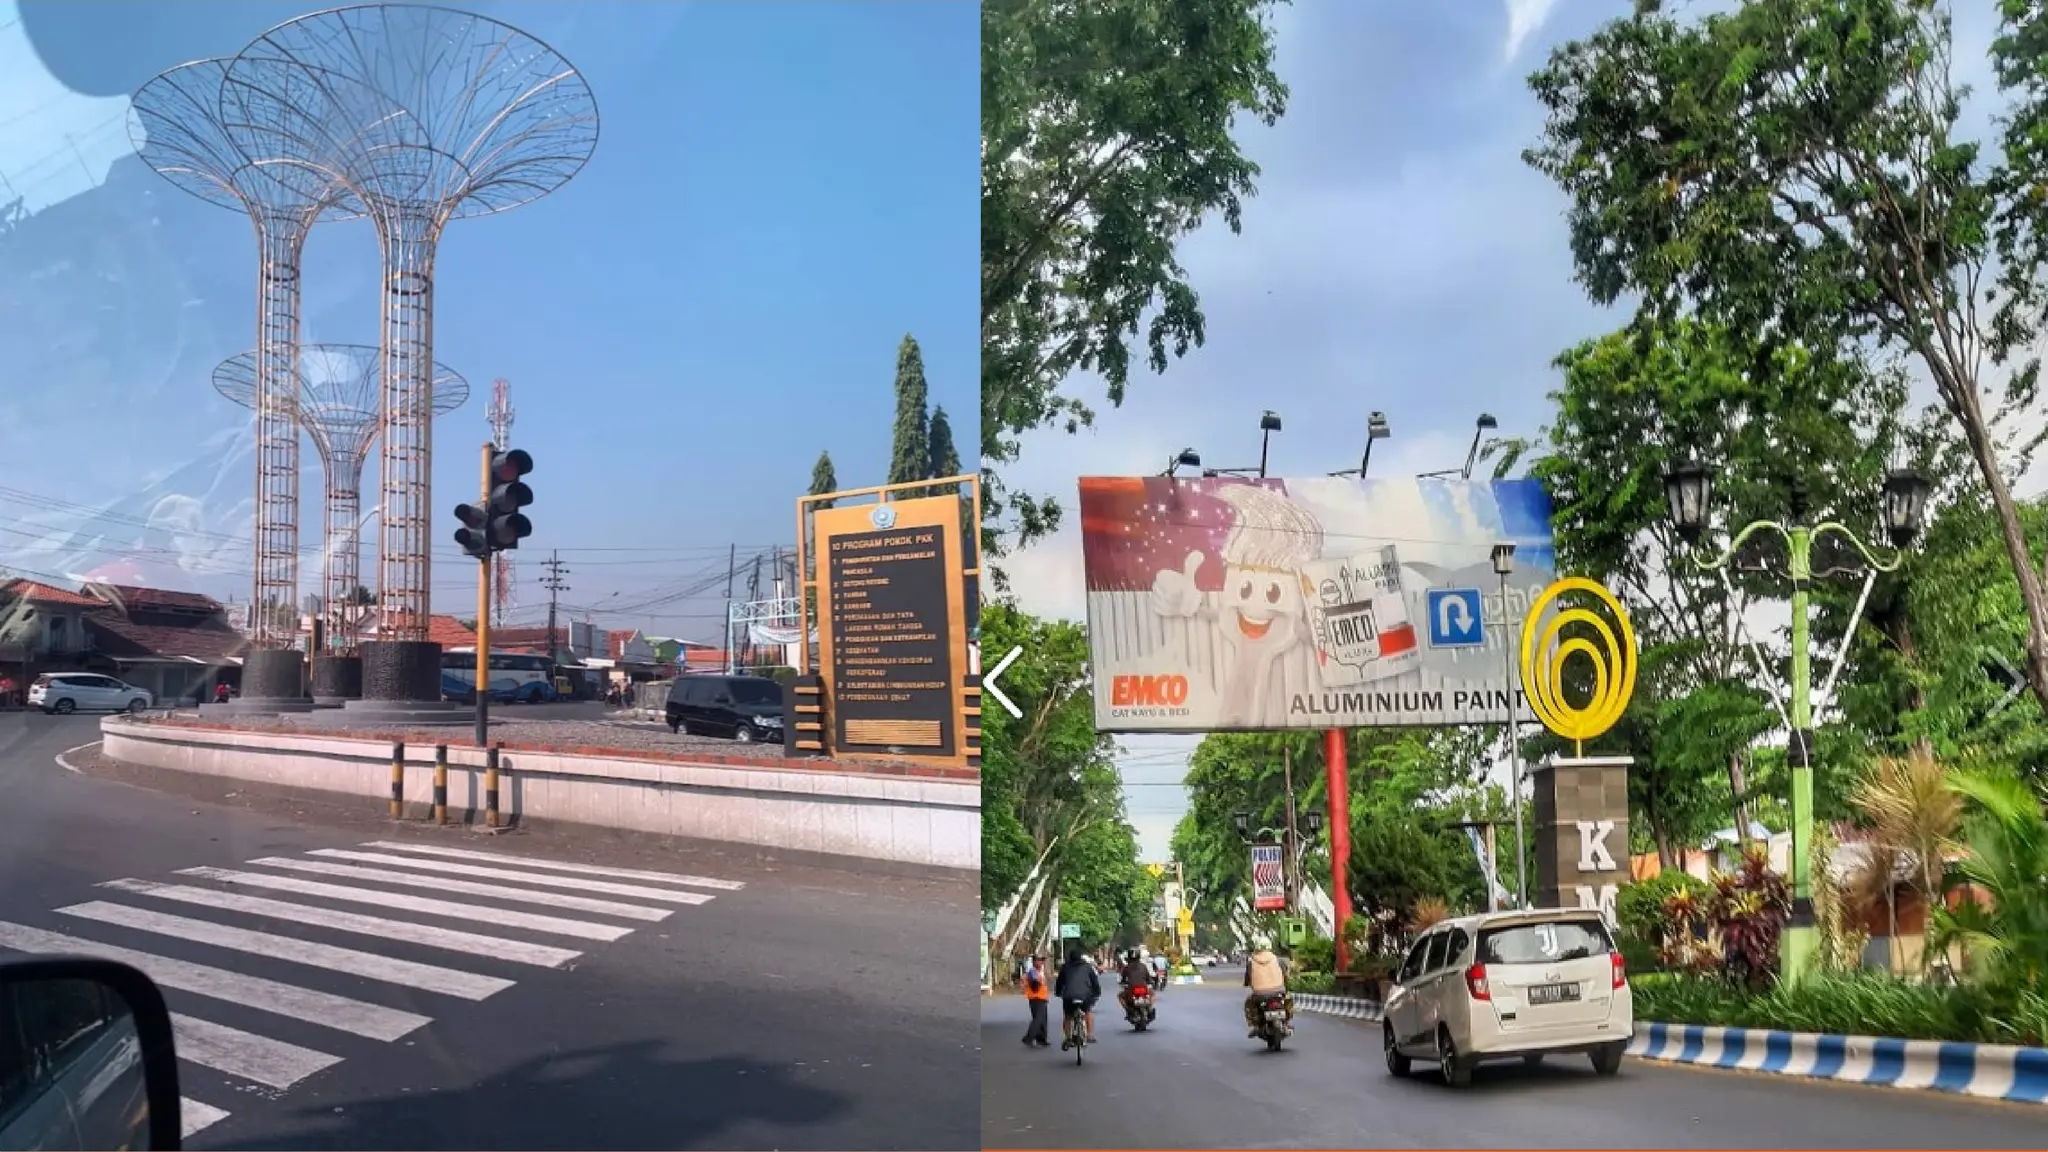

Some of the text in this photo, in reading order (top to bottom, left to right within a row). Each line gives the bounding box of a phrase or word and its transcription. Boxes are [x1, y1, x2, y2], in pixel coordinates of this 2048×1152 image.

[843, 539, 882, 549] PROGRAM
[884, 536, 912, 547] POKOK
[1330, 614, 1375, 646] EMCO
[1111, 674, 1188, 706] EMCO
[1291, 689, 1523, 714] ALUMINIUM PAINT
[1111, 709, 1129, 717] CAT
